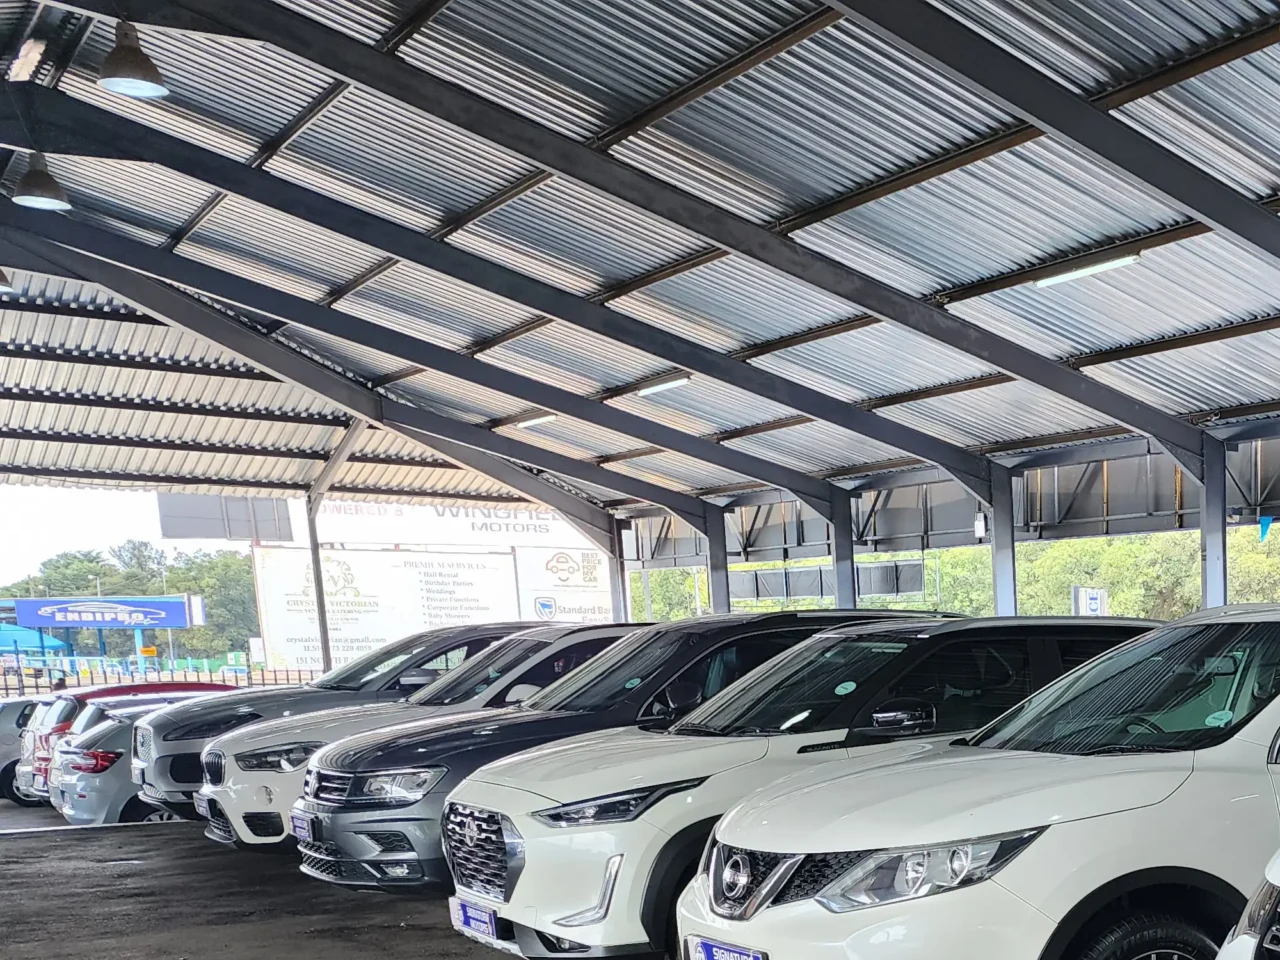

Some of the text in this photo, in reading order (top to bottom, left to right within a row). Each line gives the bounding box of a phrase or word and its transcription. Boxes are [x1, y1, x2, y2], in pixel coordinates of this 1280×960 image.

[471, 521, 549, 533] MOTORS
[329, 600, 379, 608] VICTORIAN
[427, 604, 459, 612] Corporate
[557, 606, 596, 614] Standard
[55, 612, 145, 622] ENDIPRO
